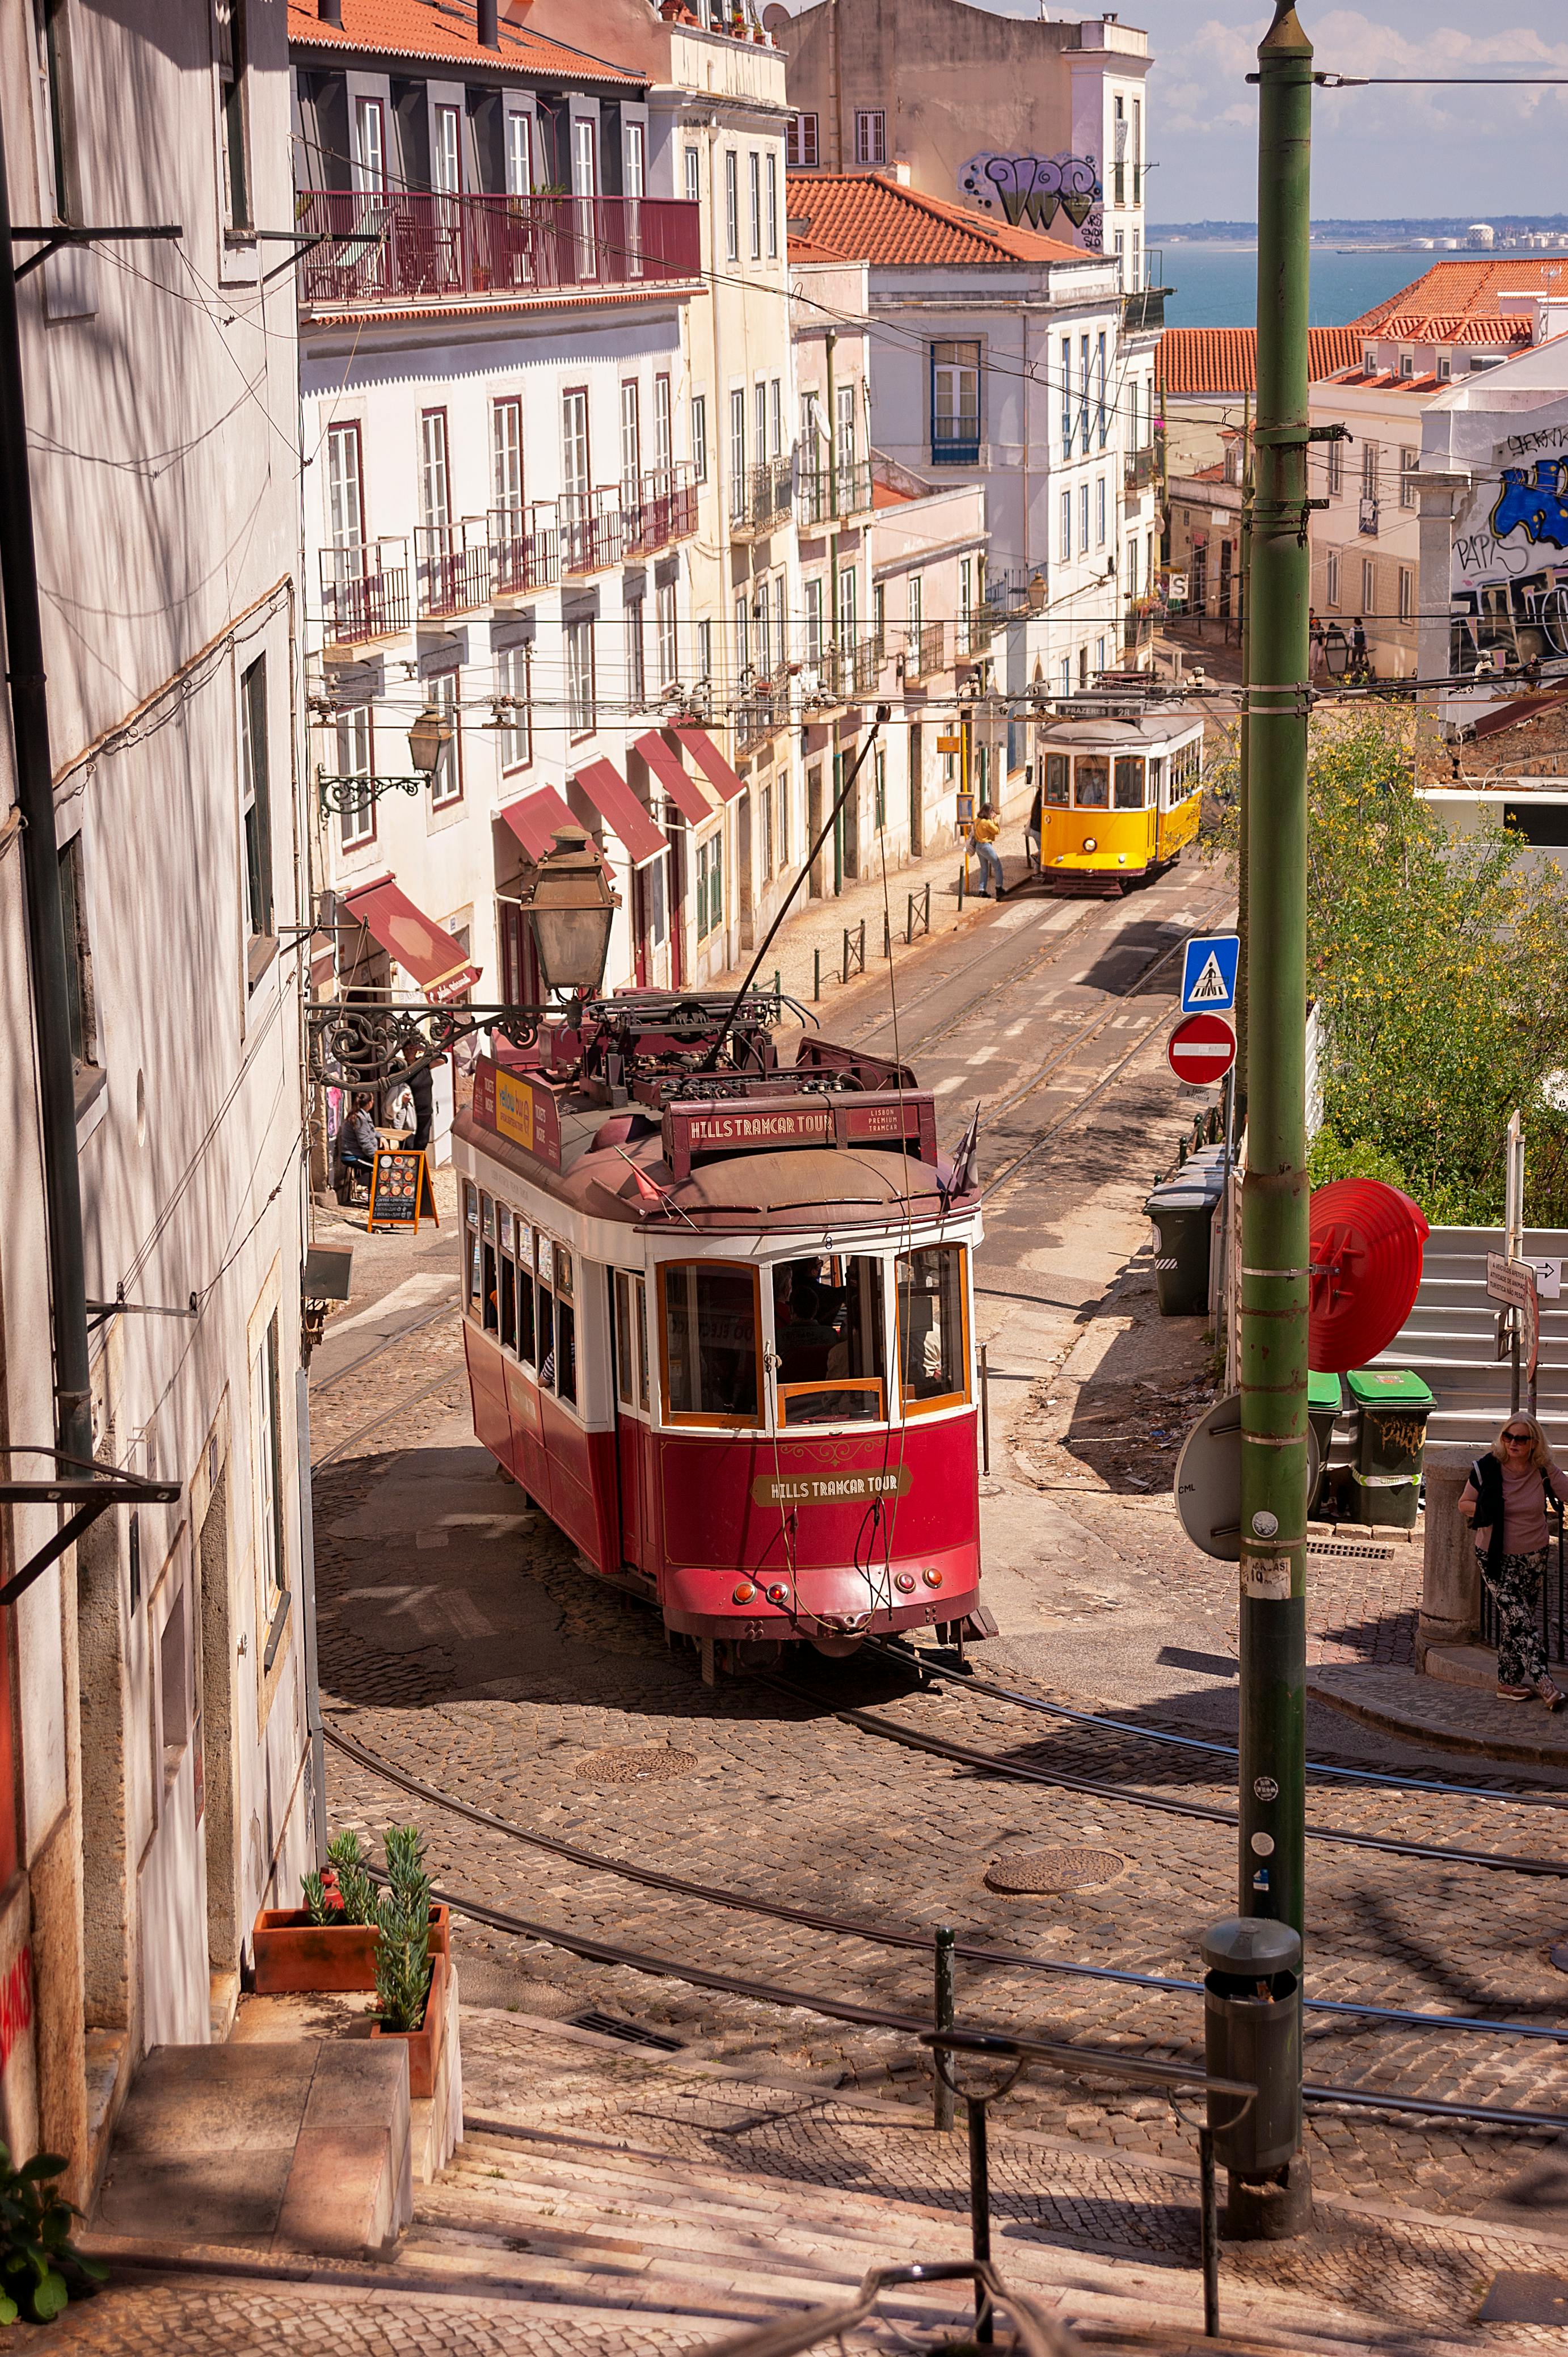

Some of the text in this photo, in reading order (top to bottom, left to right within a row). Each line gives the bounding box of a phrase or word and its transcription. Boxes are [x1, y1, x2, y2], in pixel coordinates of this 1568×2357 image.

[1118, 708, 1130, 717] 28
[691, 1115, 833, 1139] HILLS TRAMCAR TOUR
[825, 1236, 833, 1249] 8
[771, 1475, 897, 1499] HILLS TRAMCAR TOUR
[1178, 1484, 1195, 1494] CML
